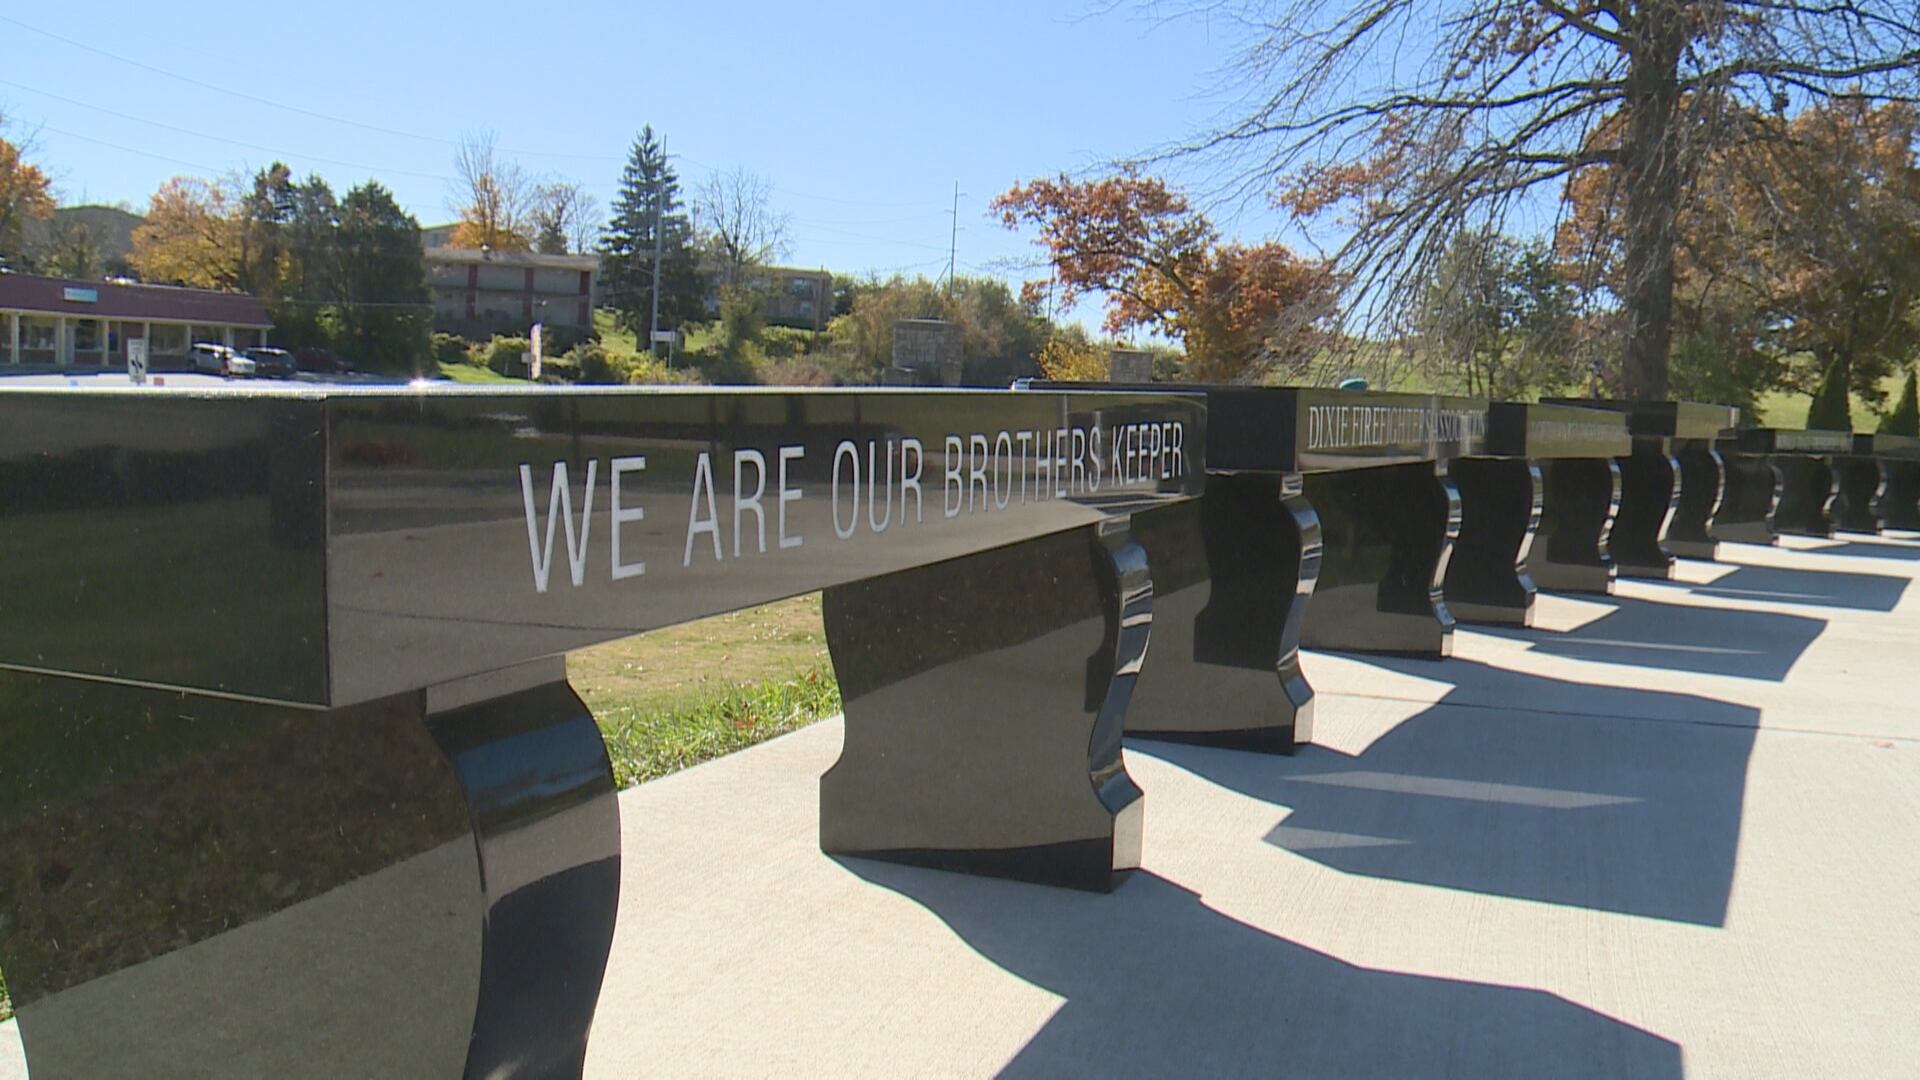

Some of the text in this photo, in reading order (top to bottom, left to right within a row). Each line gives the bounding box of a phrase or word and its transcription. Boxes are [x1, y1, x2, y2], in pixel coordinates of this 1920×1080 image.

[1308, 406, 1349, 448] DIXIE
[1350, 406, 1432, 446] FIREFIGHTERS
[1430, 408, 1486, 442] ASSOCTION
[519, 421, 1184, 593] WE ARE OUR BROTHERS KEEPER
